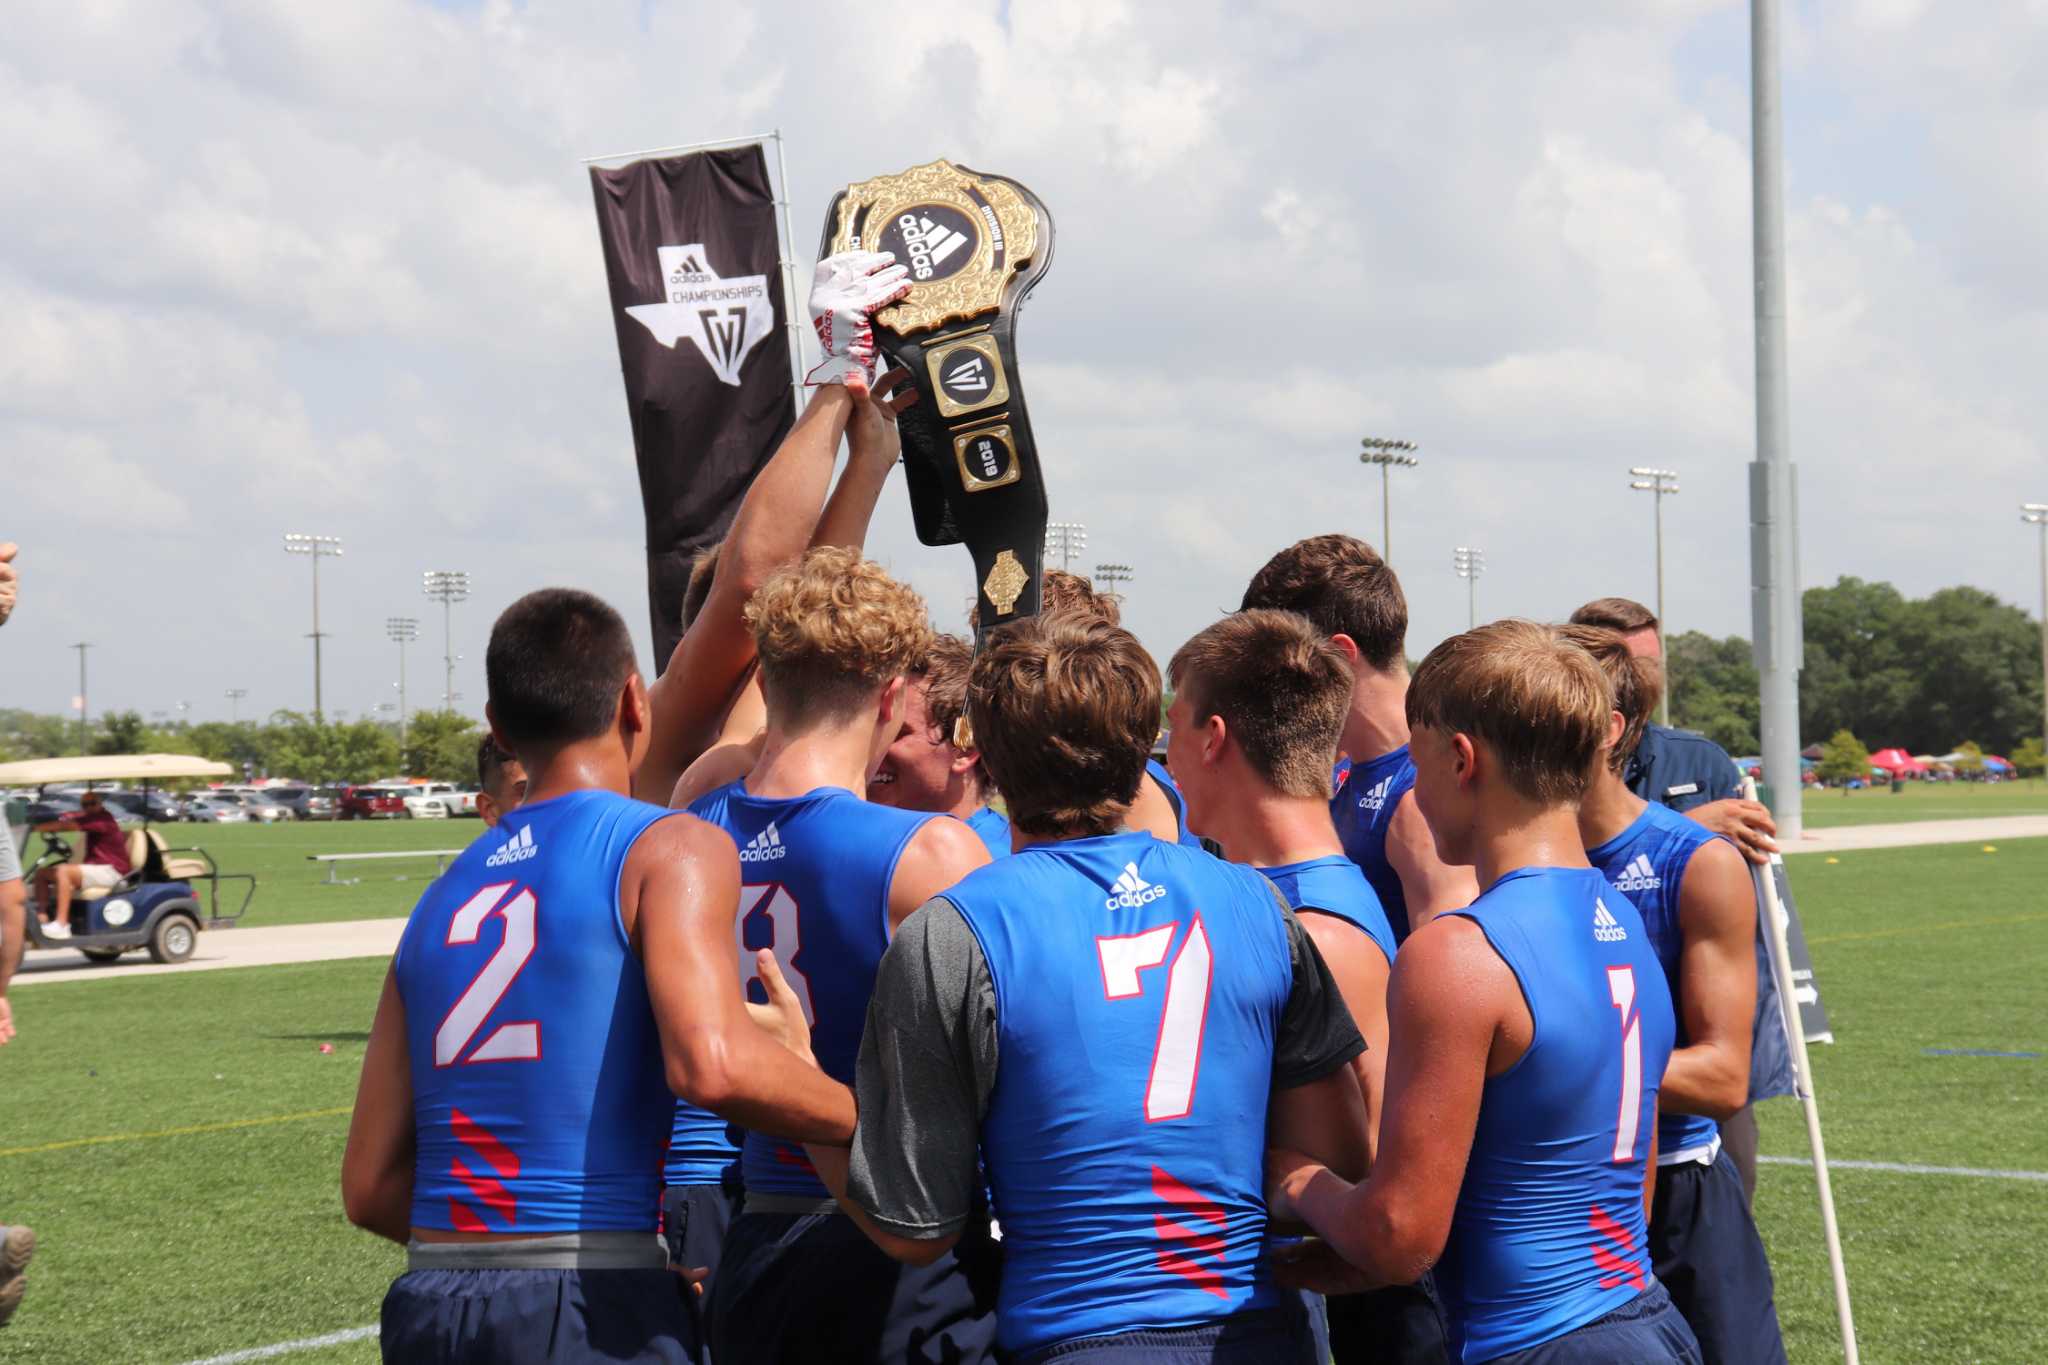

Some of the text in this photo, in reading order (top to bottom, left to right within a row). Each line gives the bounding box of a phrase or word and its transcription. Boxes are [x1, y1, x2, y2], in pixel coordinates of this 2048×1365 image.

[898, 214, 933, 280] adidas
[670, 273, 712, 285] adidas
[672, 285, 763, 304] CHAMPIONSHIPS
[978, 440, 998, 477] 2019
[486, 844, 538, 868] adidas
[739, 844, 786, 862] adidas
[1105, 884, 1167, 911] adidas
[433, 880, 541, 1069] 2
[1096, 910, 1213, 1124] 7
[1605, 963, 1642, 1165] 1
